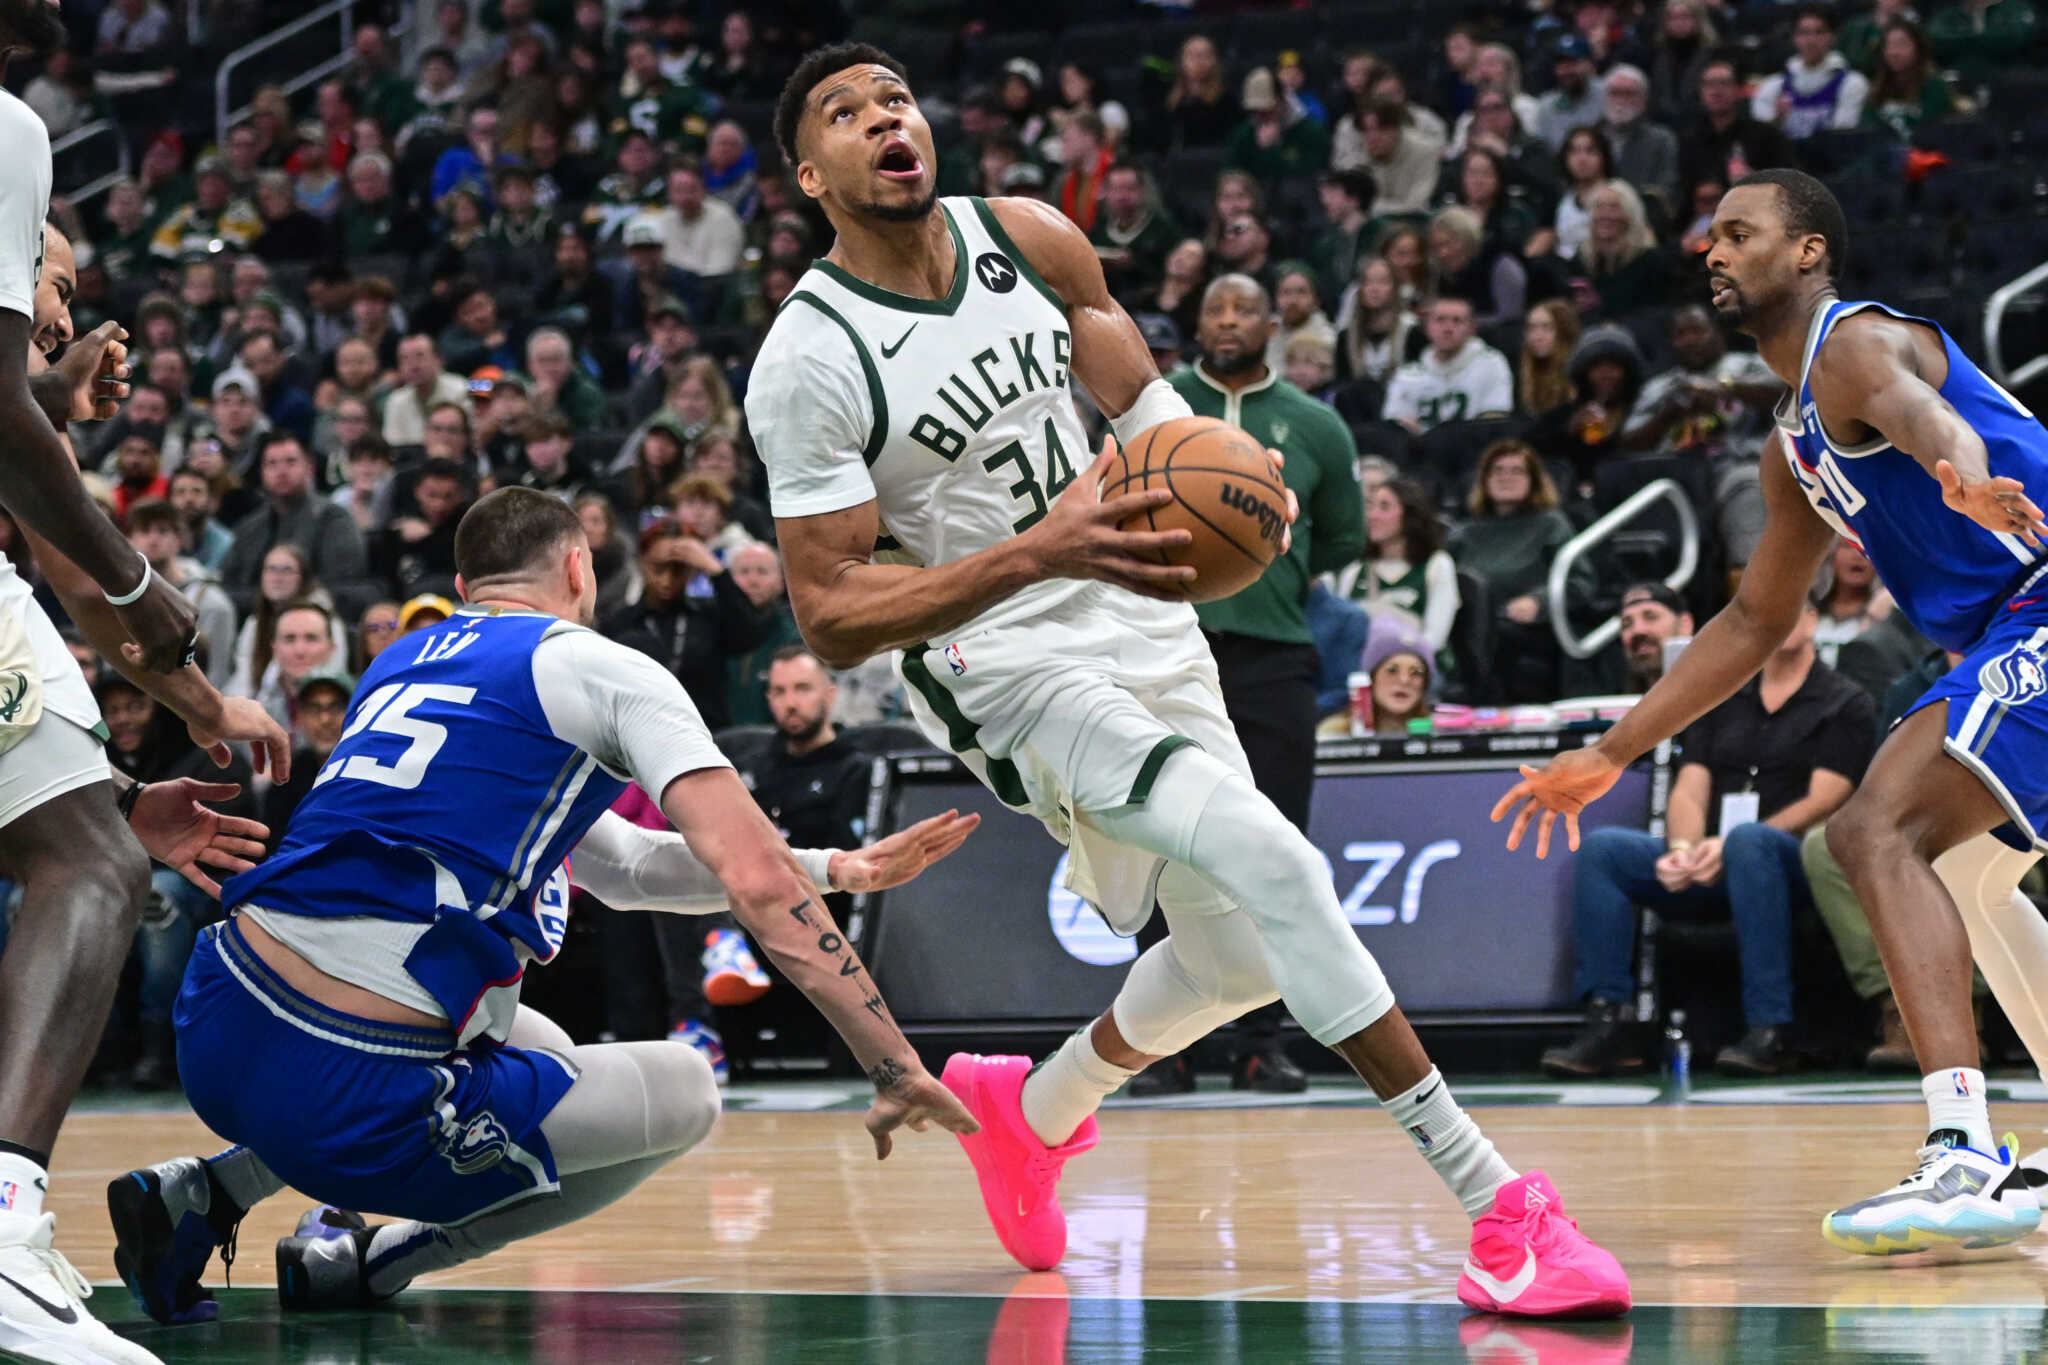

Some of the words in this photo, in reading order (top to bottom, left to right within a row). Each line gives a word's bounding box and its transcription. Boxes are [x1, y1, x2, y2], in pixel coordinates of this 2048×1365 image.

[908, 330, 1070, 463] BUCKS
[982, 416, 1078, 535] 34
[412, 631, 481, 666] LEN
[311, 682, 478, 790] 25
[789, 899, 887, 1023] LOVE
